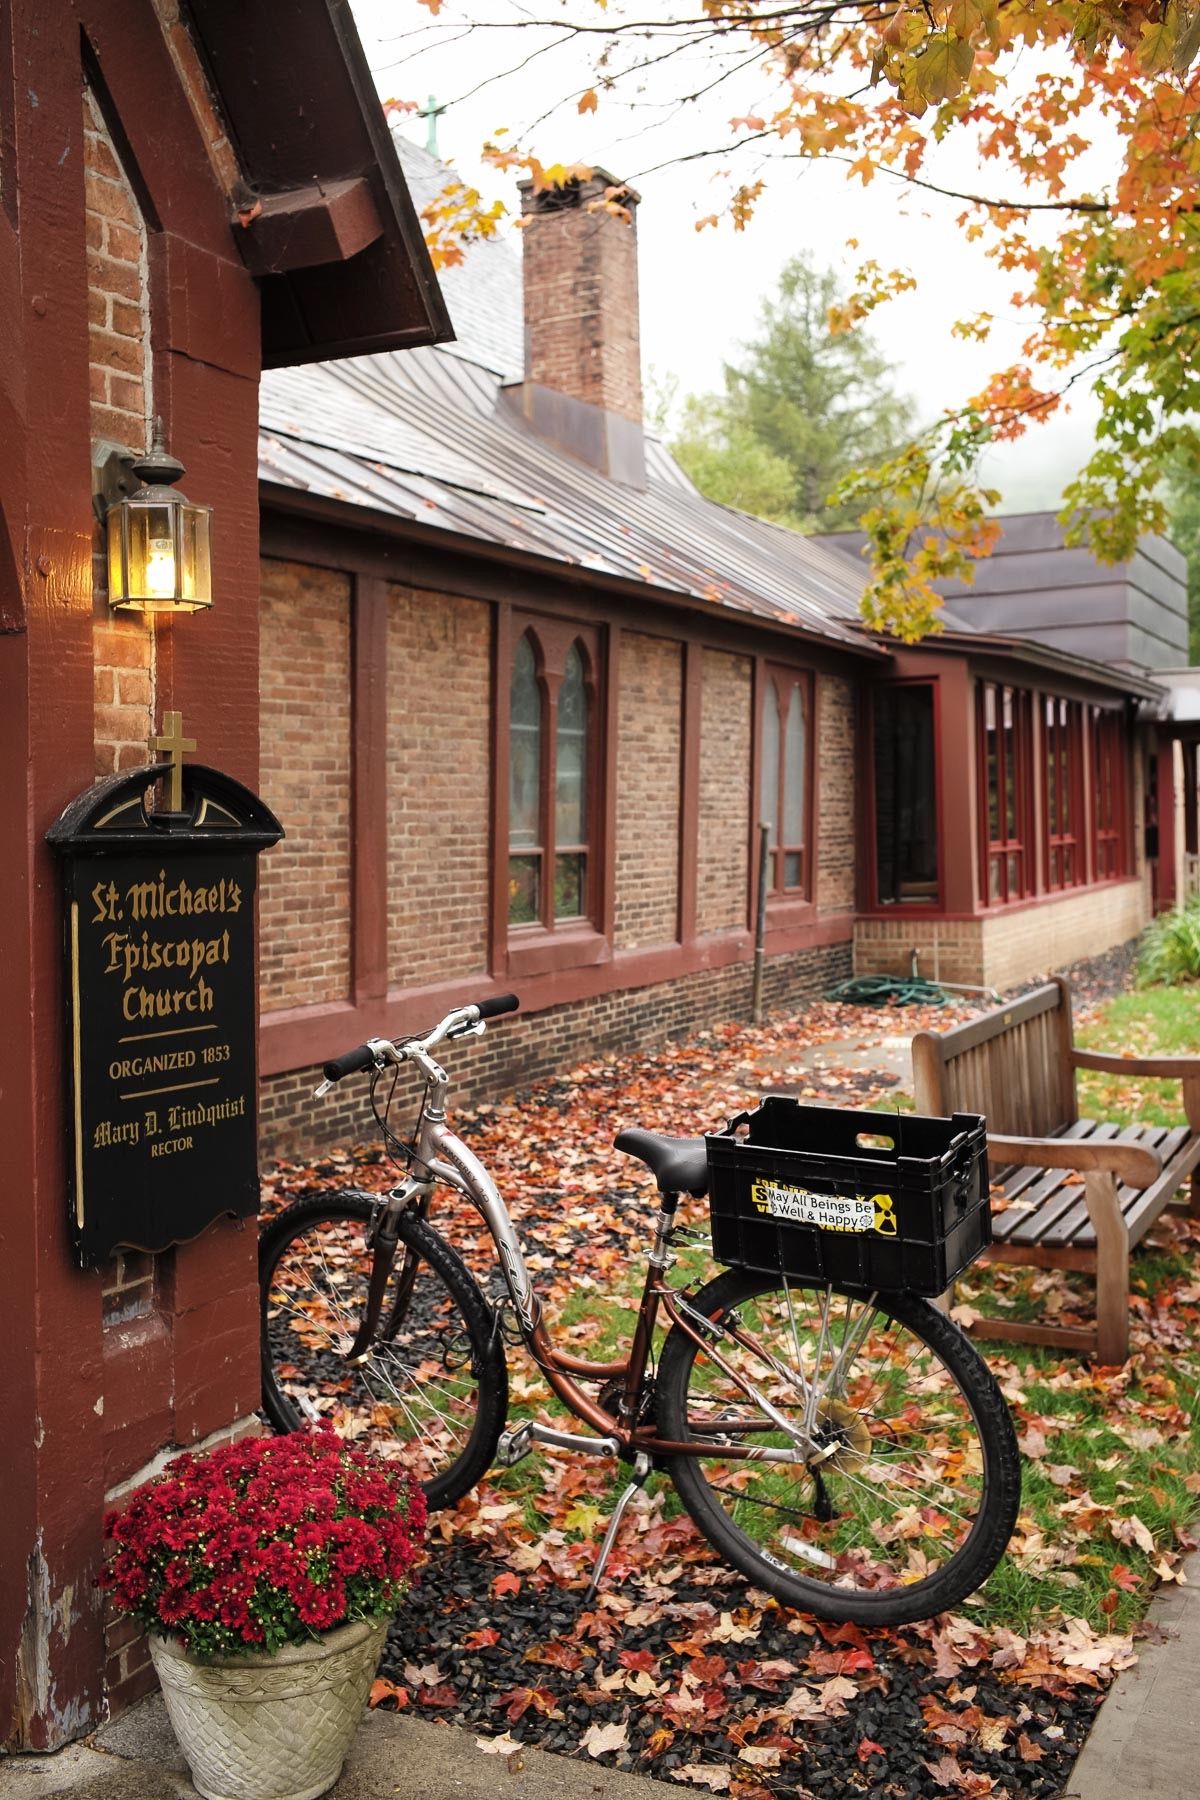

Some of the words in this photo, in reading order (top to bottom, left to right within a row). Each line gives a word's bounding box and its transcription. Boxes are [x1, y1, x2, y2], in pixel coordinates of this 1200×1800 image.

[91, 880, 123, 923] St.
[125, 868, 242, 921] Michael's
[101, 928, 230, 984] Episcopal
[122, 975, 214, 1021] Church
[109, 1050, 196, 1080] ORGANIZED
[201, 1044, 231, 1064] 1853
[93, 1120, 139, 1149] Mary
[144, 1111, 163, 1137] D.
[168, 1095, 246, 1132] Lindquist
[151, 1136, 193, 1158] RECTOR
[440, 1143, 478, 1182] MONTEREY
[768, 1189, 789, 1205] May
[792, 1194, 807, 1207] All
[811, 1197, 851, 1214] Beings
[855, 1202, 872, 1213] Be
[779, 1204, 804, 1218] Well
[807, 1210, 816, 1221] &
[819, 1211, 858, 1228] Happy
